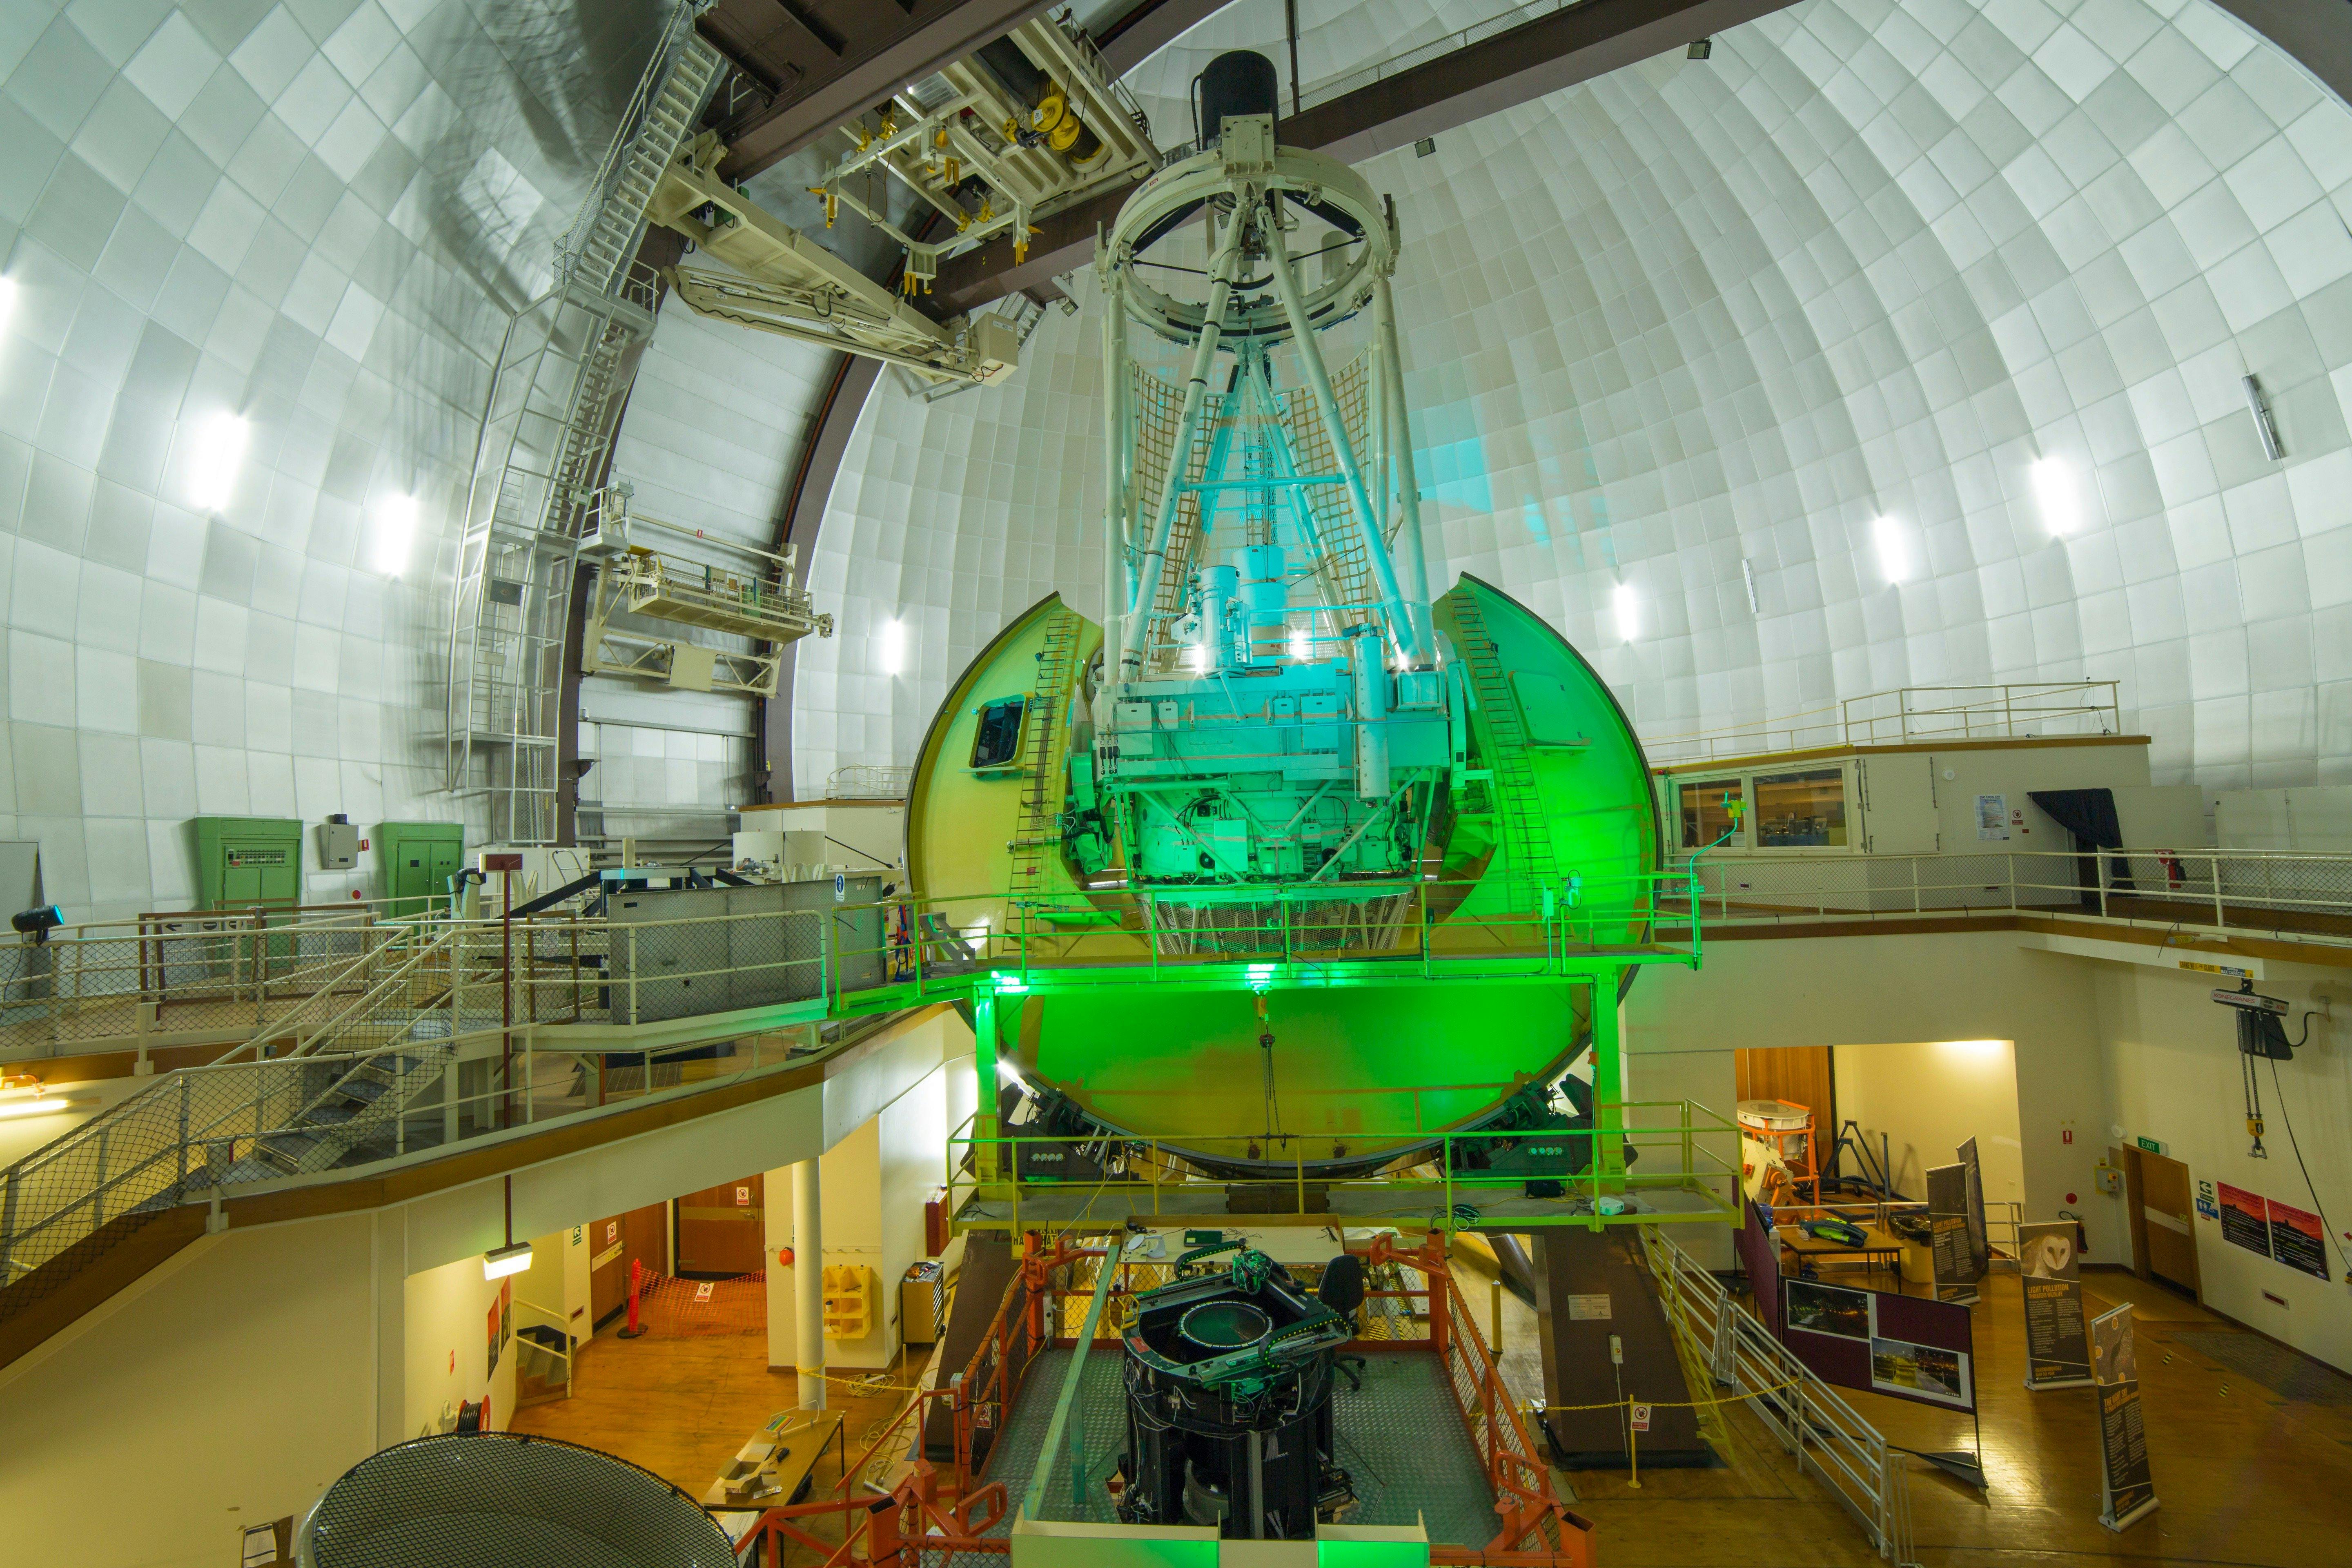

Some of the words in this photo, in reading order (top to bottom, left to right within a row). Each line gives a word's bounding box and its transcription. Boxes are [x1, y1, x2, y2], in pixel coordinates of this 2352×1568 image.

[2213, 993, 2256, 1004] KONECRANES
[2141, 1139, 2155, 1151] EXIT
[2042, 1284, 2069, 1292] POLLUTION
